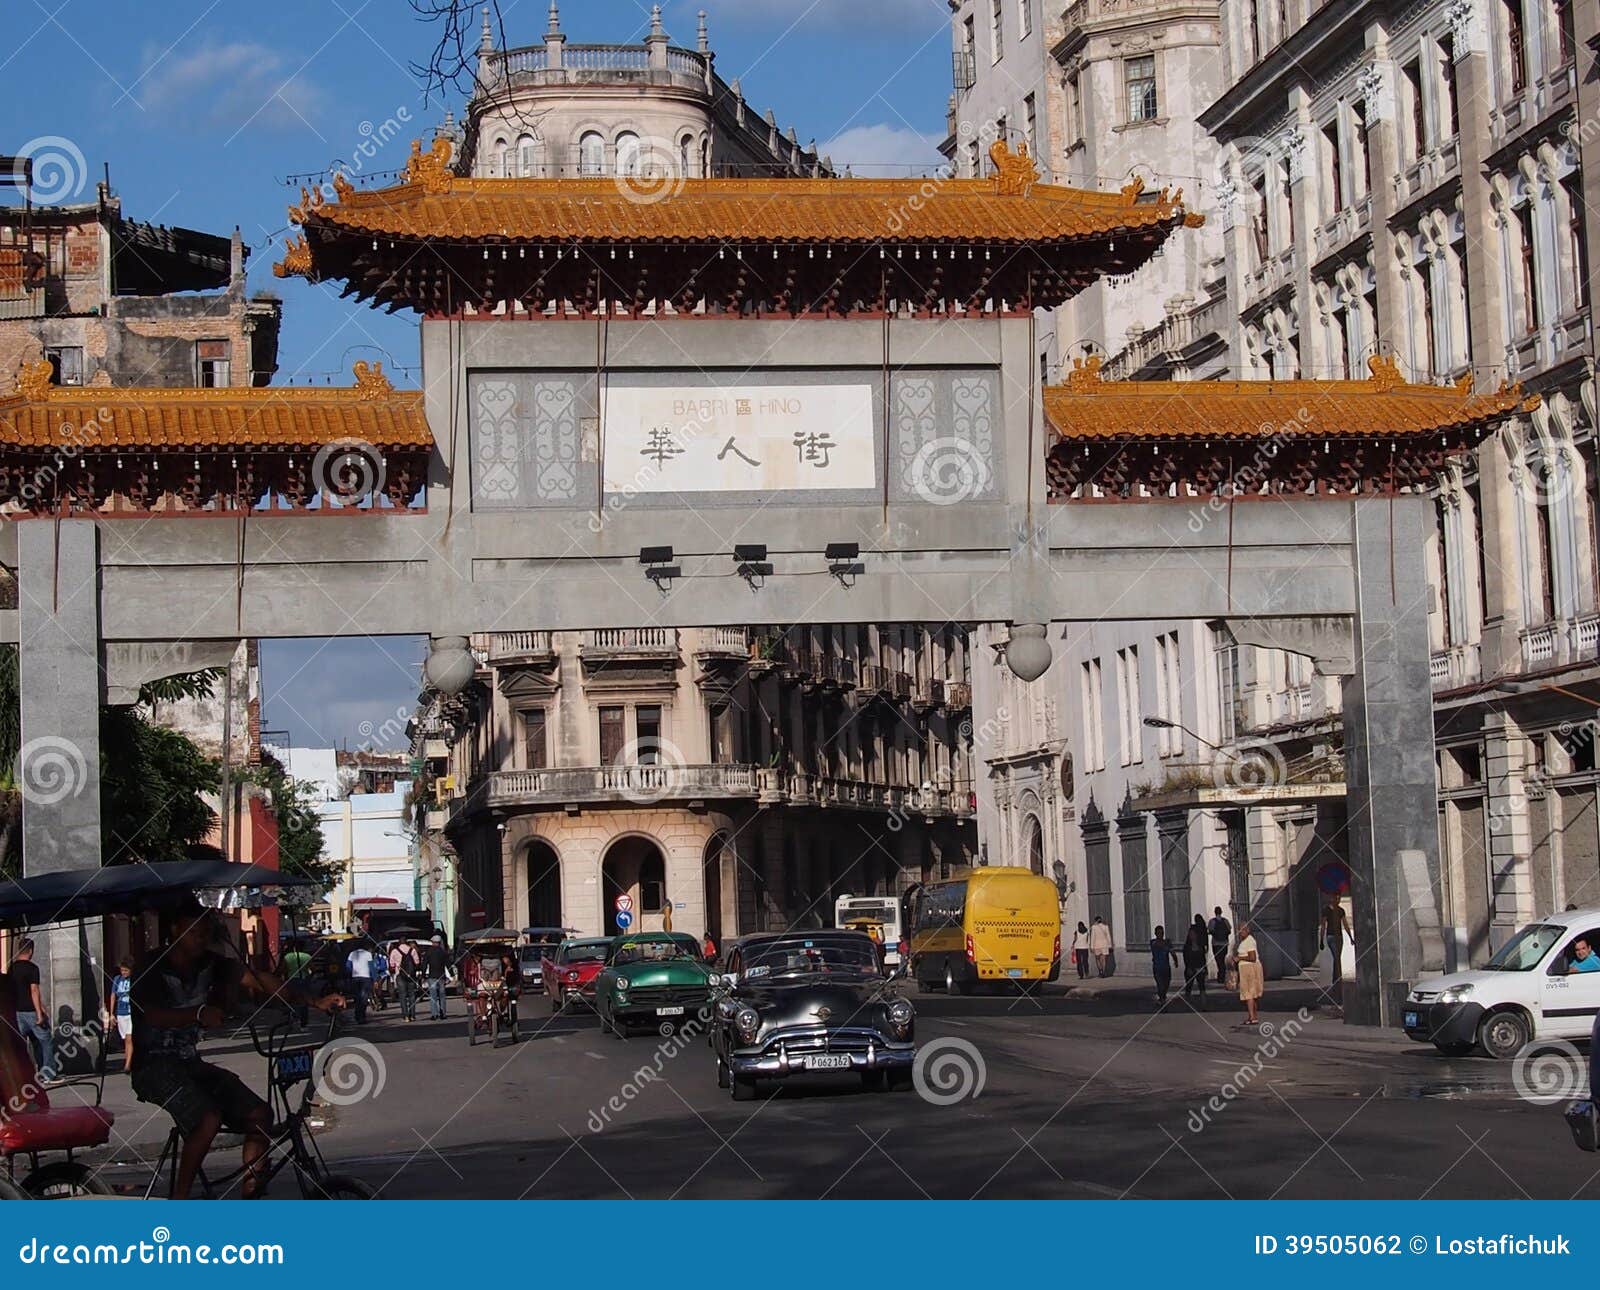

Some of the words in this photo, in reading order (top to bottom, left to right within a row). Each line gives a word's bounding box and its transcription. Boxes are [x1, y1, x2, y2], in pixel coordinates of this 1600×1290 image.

[759, 398, 802, 415] HINO
[639, 426, 837, 472] 華人街
